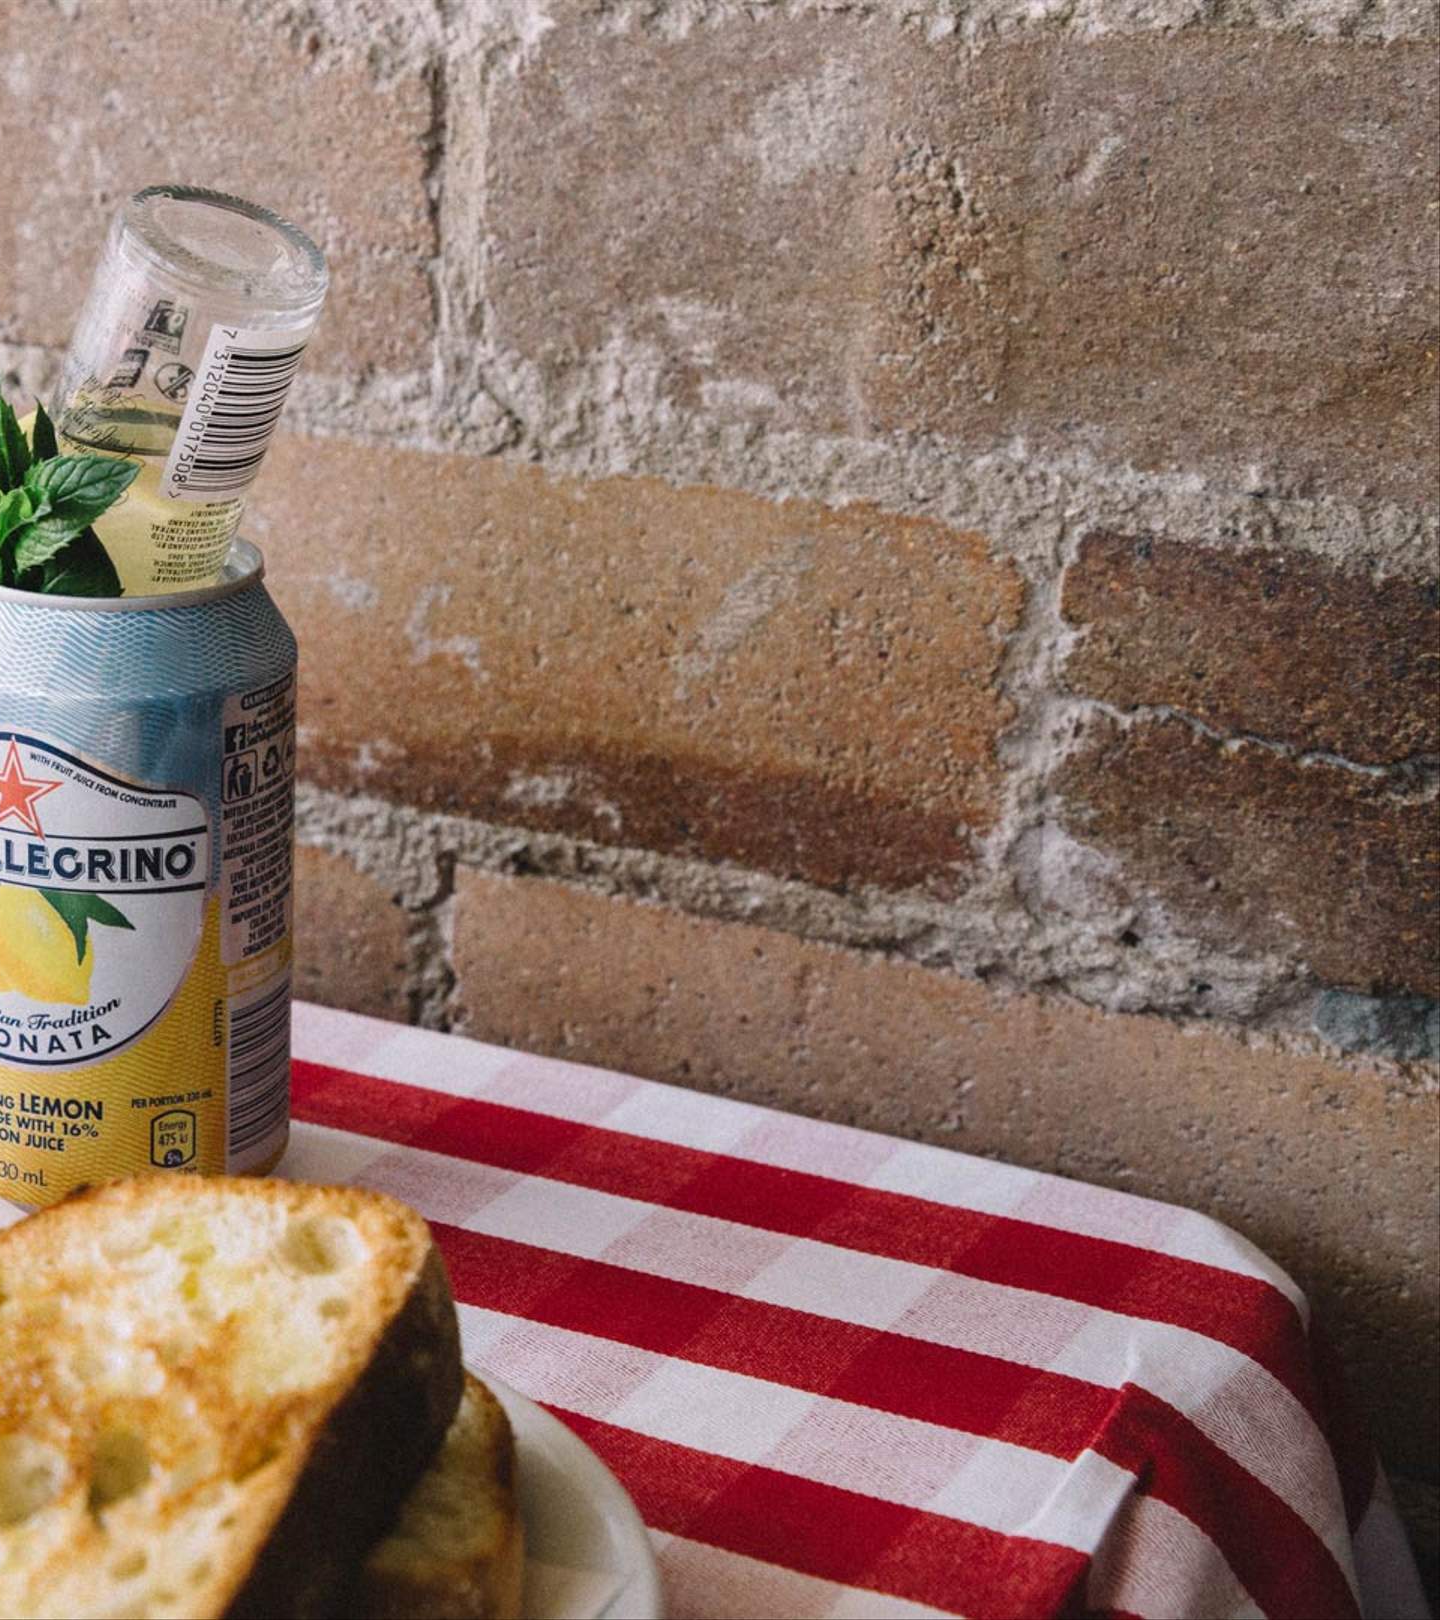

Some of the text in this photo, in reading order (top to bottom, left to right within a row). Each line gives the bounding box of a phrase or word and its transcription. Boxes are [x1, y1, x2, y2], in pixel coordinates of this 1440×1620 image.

[151, 524, 185, 535] CENTRAL
[168, 520, 199, 528] ZEALAND
[30, 752, 177, 808] WITH FRUIT JUICE FROM CONCENTRATE
[27, 997, 121, 1031] Tradition
[20, 1093, 103, 1121] LEMON
[16, 1116, 54, 1134] WITH
[62, 1122, 99, 1138] 16%
[25, 1134, 65, 1151] JUICE
[23, 1169, 48, 1187] mL
